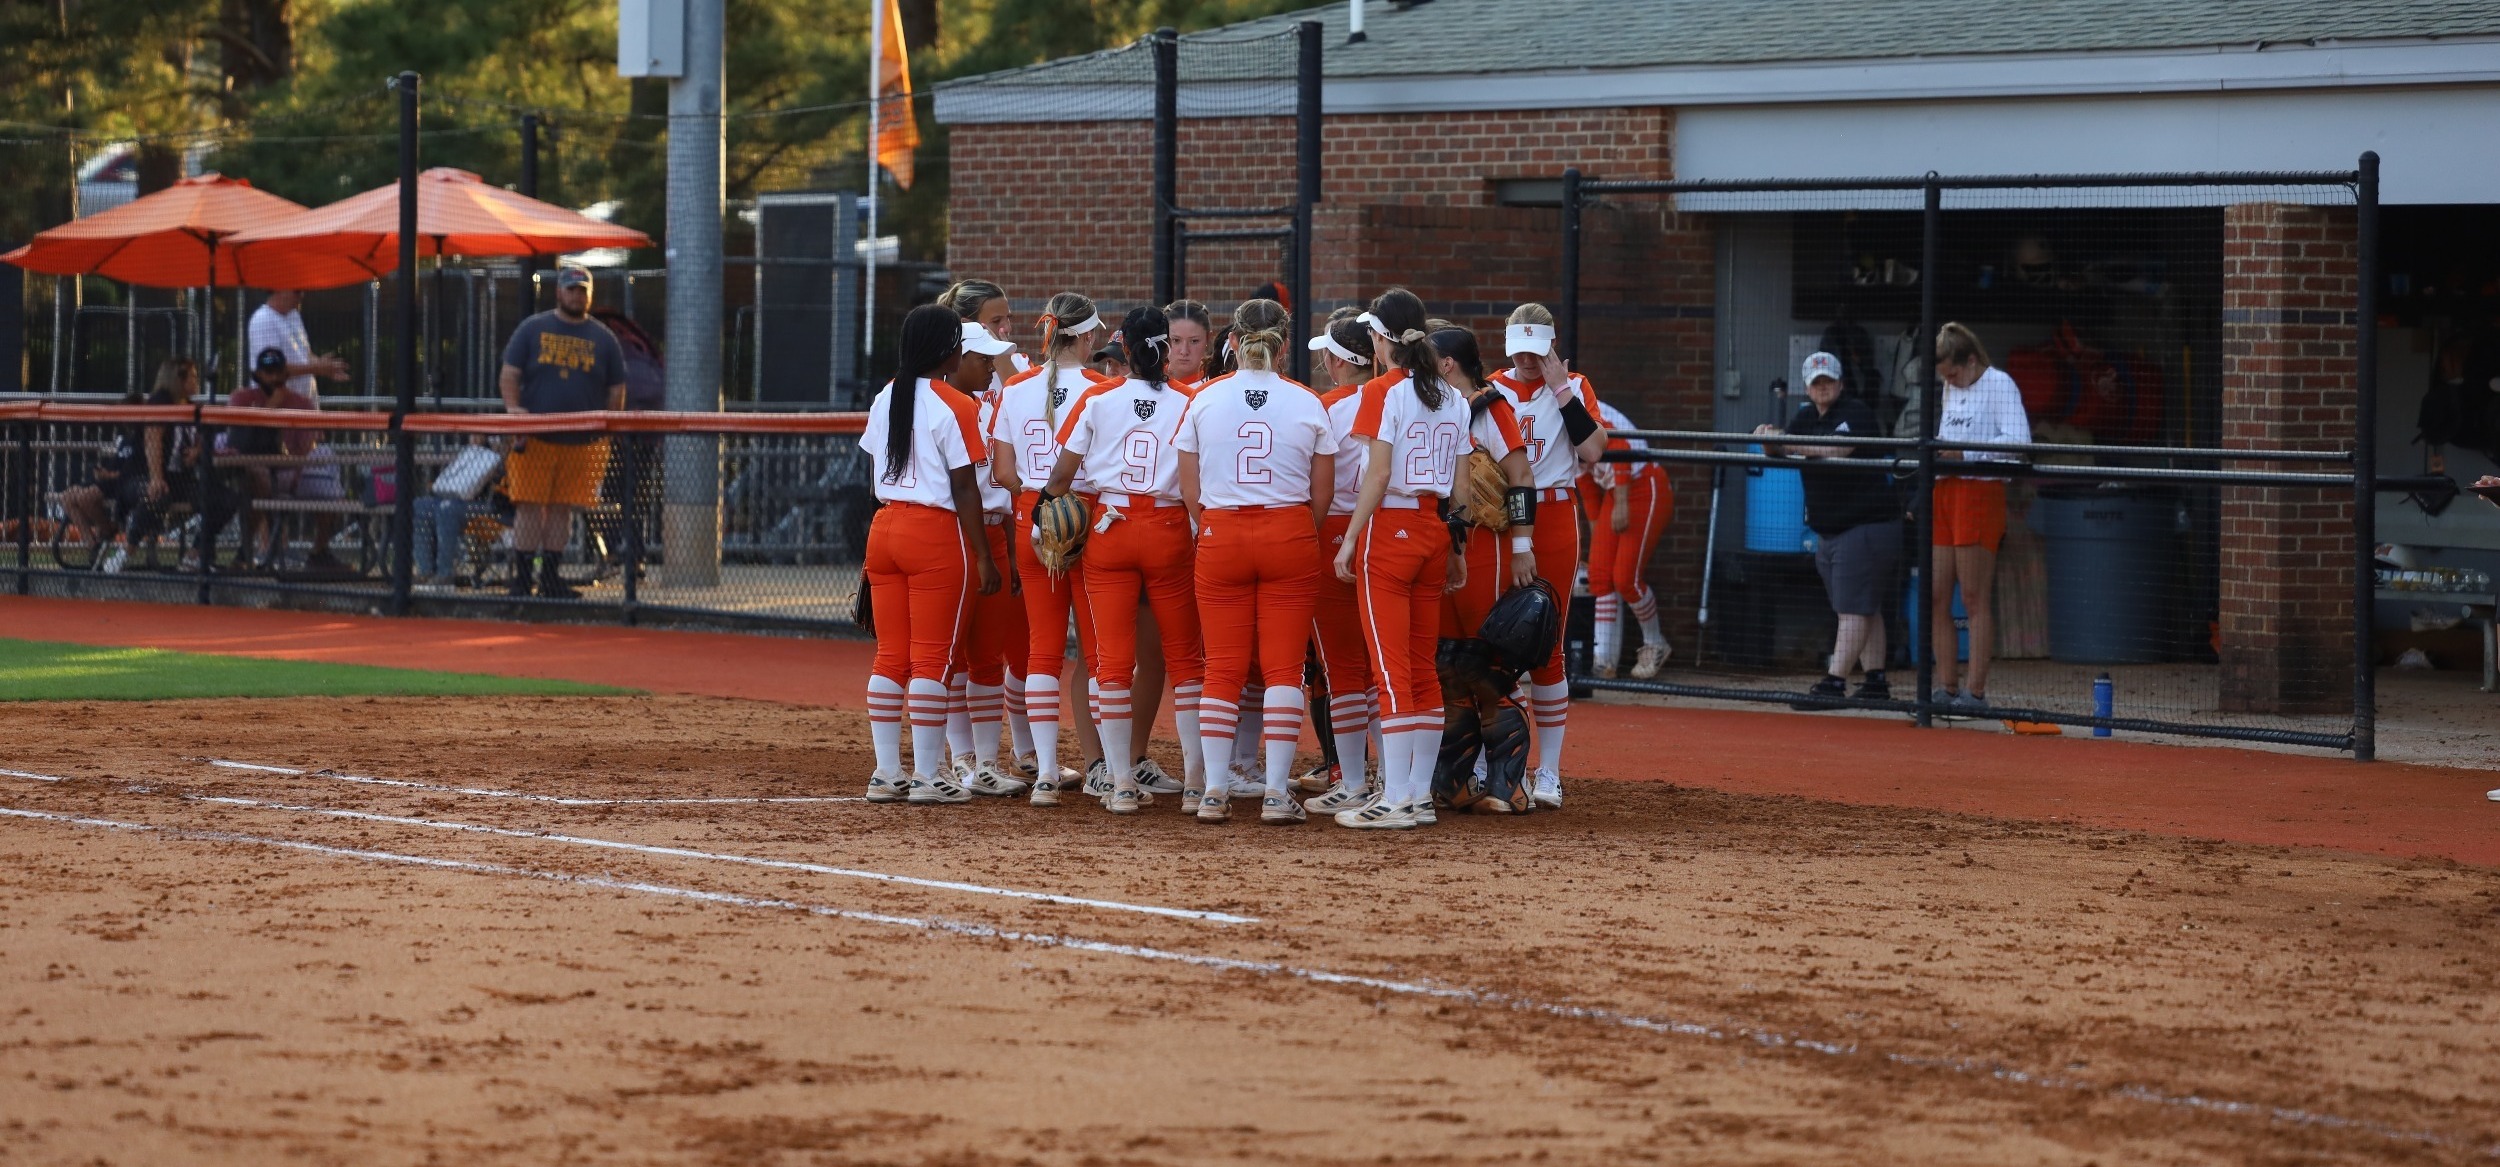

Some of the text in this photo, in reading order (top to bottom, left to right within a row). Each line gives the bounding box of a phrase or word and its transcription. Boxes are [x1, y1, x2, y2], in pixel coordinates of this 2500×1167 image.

[1120, 429, 1159, 493] 9
[1236, 421, 1273, 485] 2
[1405, 421, 1460, 485] 20
